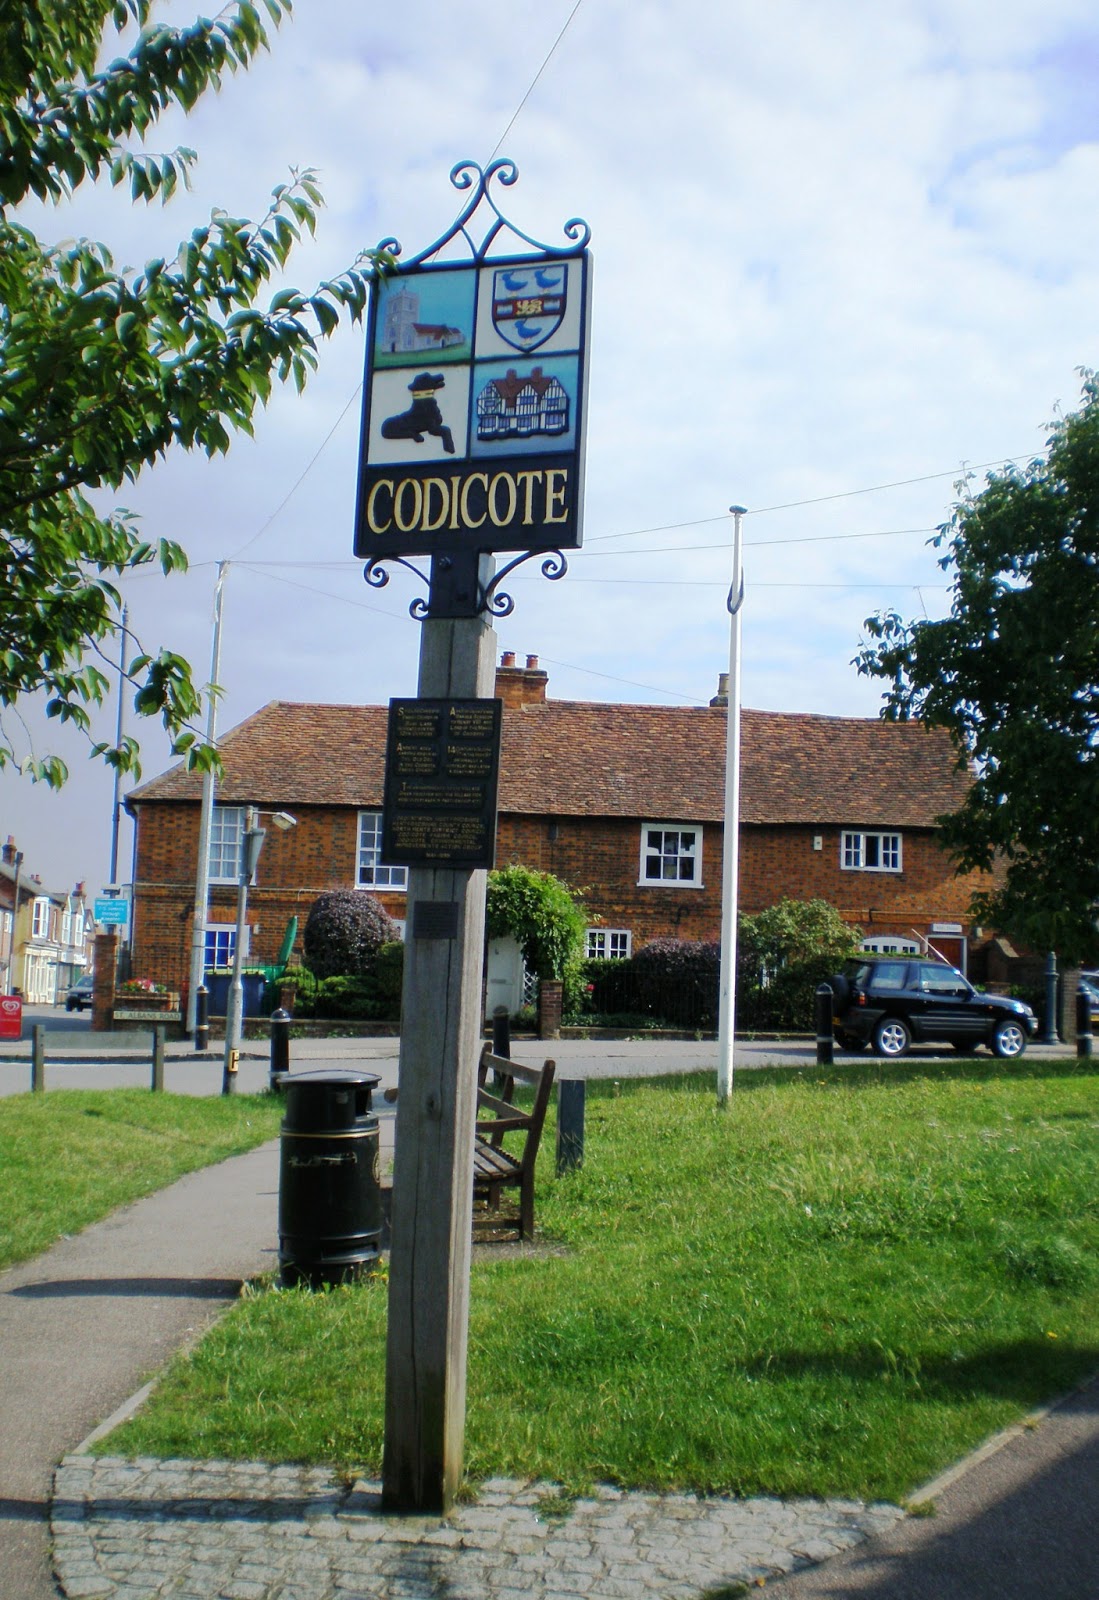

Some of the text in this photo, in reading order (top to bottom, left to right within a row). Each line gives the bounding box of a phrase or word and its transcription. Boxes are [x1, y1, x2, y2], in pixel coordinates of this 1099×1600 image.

[367, 468, 569, 534] CODICOTE
[127, 1011, 157, 1019] ALBANS
[159, 1012, 180, 1020] ROAD
